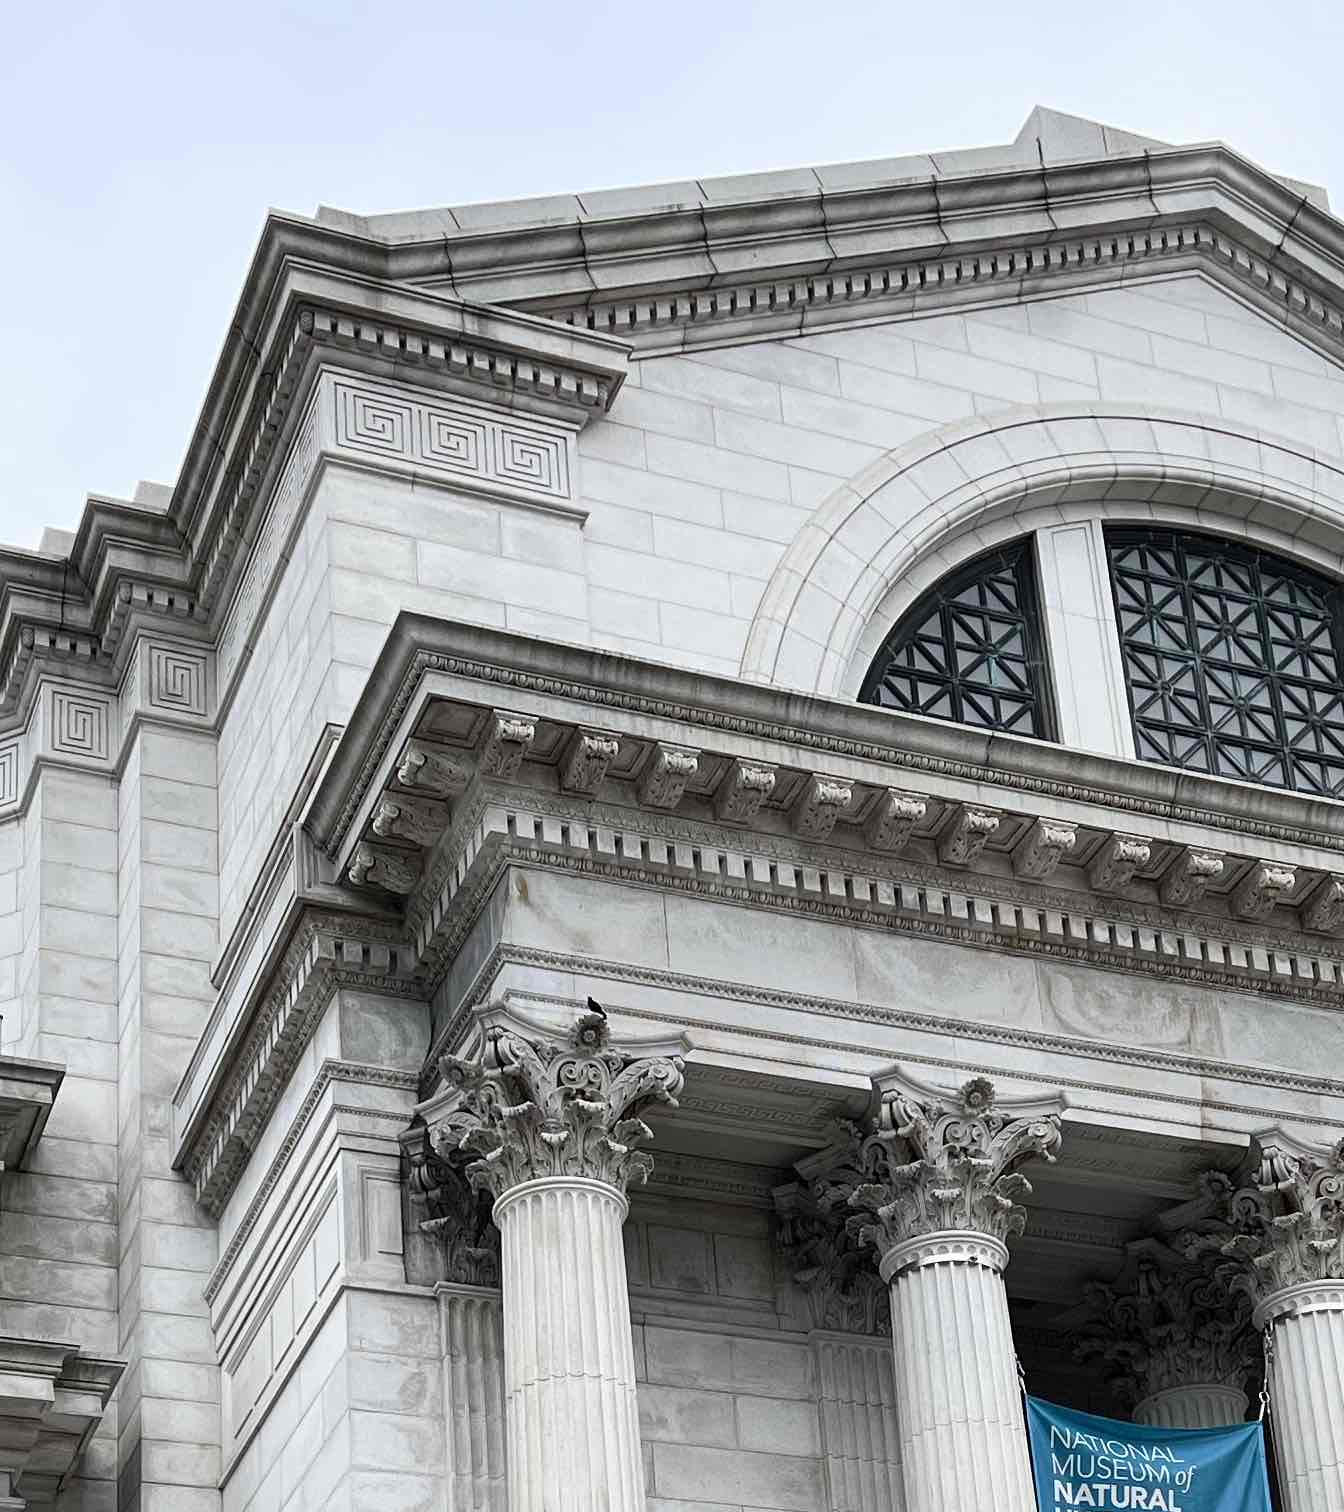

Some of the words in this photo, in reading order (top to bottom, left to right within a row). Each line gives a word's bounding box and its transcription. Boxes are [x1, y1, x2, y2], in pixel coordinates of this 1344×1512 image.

[1050, 1425, 1185, 1463] NATIONAL
[1051, 1453, 1170, 1484] MUSEUM
[1175, 1465, 1197, 1493] of
[1053, 1479, 1182, 1512] NATURAL
